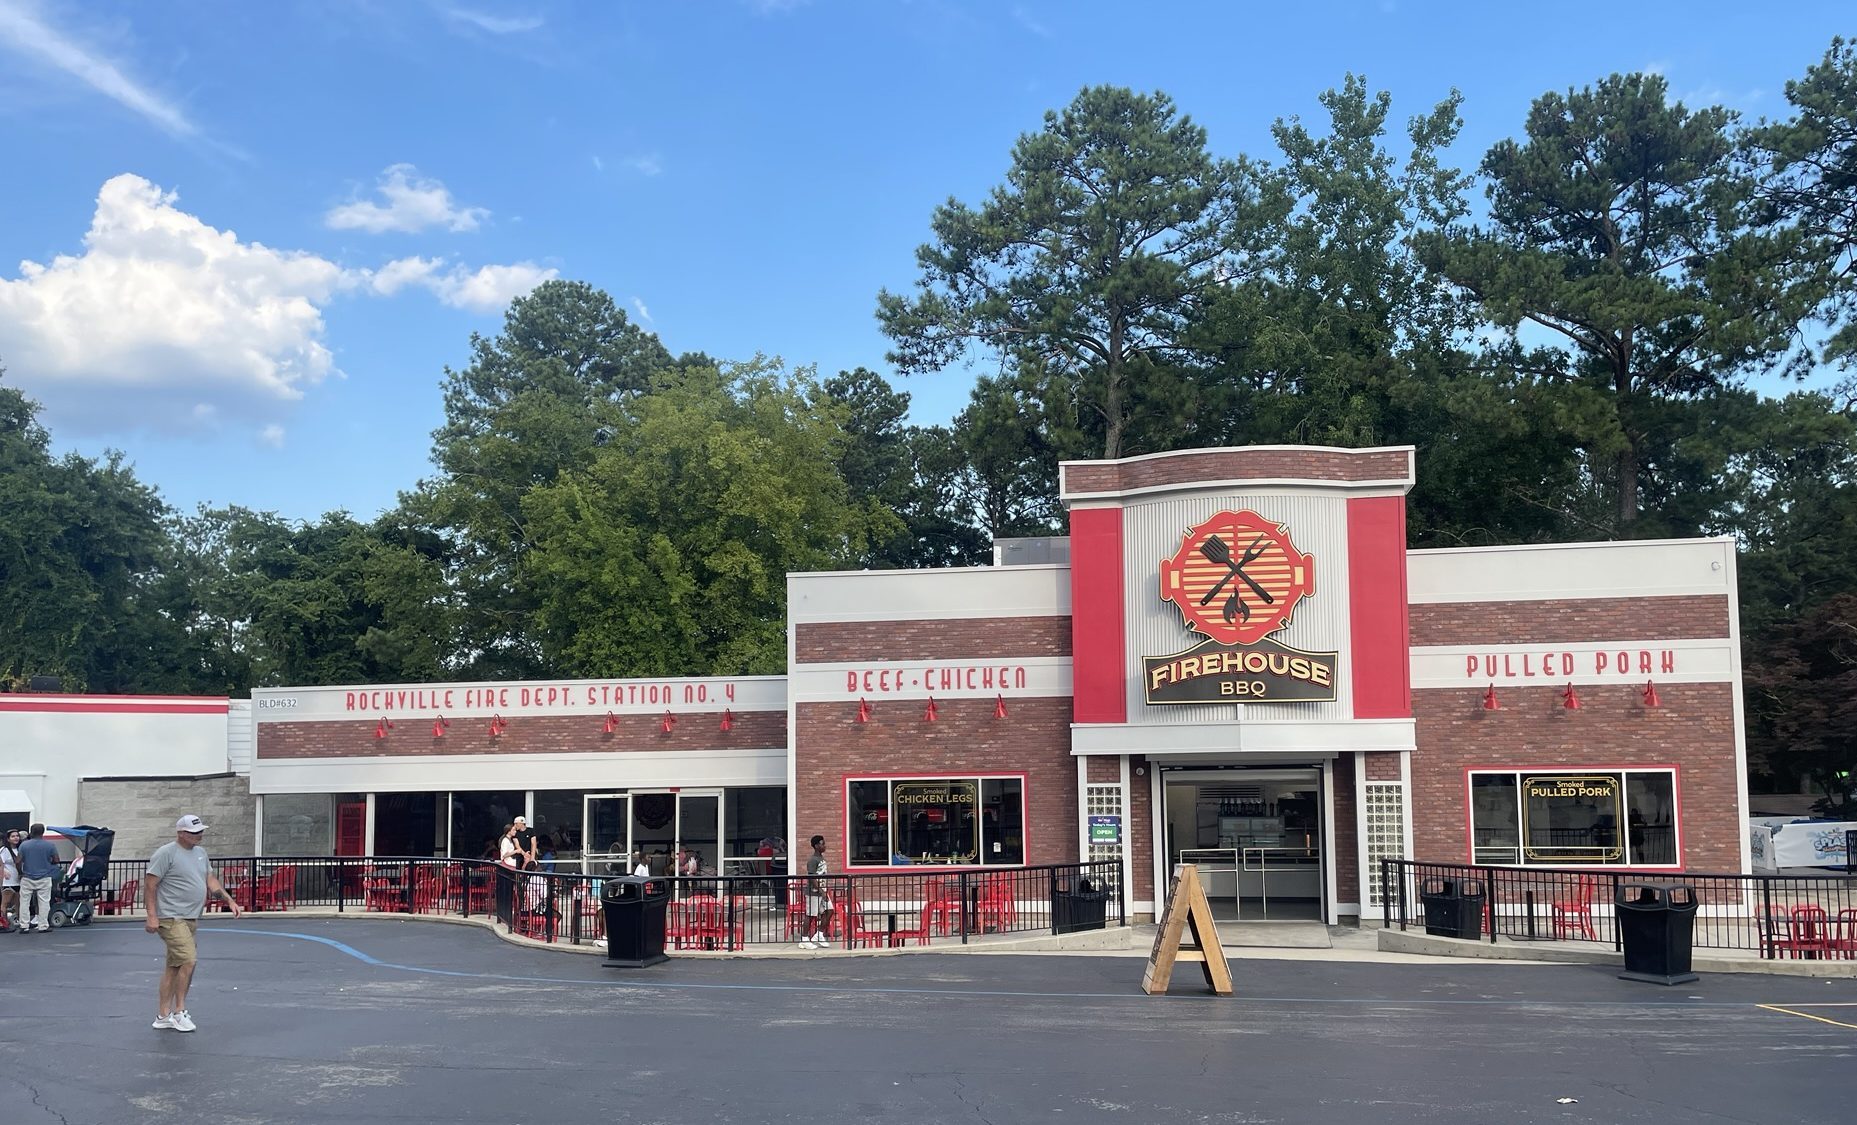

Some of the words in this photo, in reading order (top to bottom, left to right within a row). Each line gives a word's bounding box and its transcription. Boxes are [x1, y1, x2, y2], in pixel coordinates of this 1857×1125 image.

[1466, 653, 1574, 677] PULLED
[1595, 650, 1674, 674] PORK
[847, 670, 904, 692] BEEF
[925, 666, 1026, 690] CHICKEN
[1151, 652, 1331, 691] FIREHOUSE
[1220, 680, 1266, 697] BBQ
[259, 699, 297, 709] BLD#632
[346, 690, 453, 711] ROCKVILLE
[465, 688, 509, 708] FIRE
[521, 687, 576, 706] DEPT.
[587, 685, 671, 705] STATION
[684, 683, 715, 704] NO.
[726, 683, 735, 703] 4
[923, 787, 947, 795] Smoked
[1556, 780, 1584, 788] Smoked
[897, 794, 944, 804] CHICKEN
[947, 794, 974, 803] LEGS
[1531, 788, 1577, 797] PULLED
[1578, 787, 1611, 797] PORK
[1813, 836, 1847, 851] SPLAS
